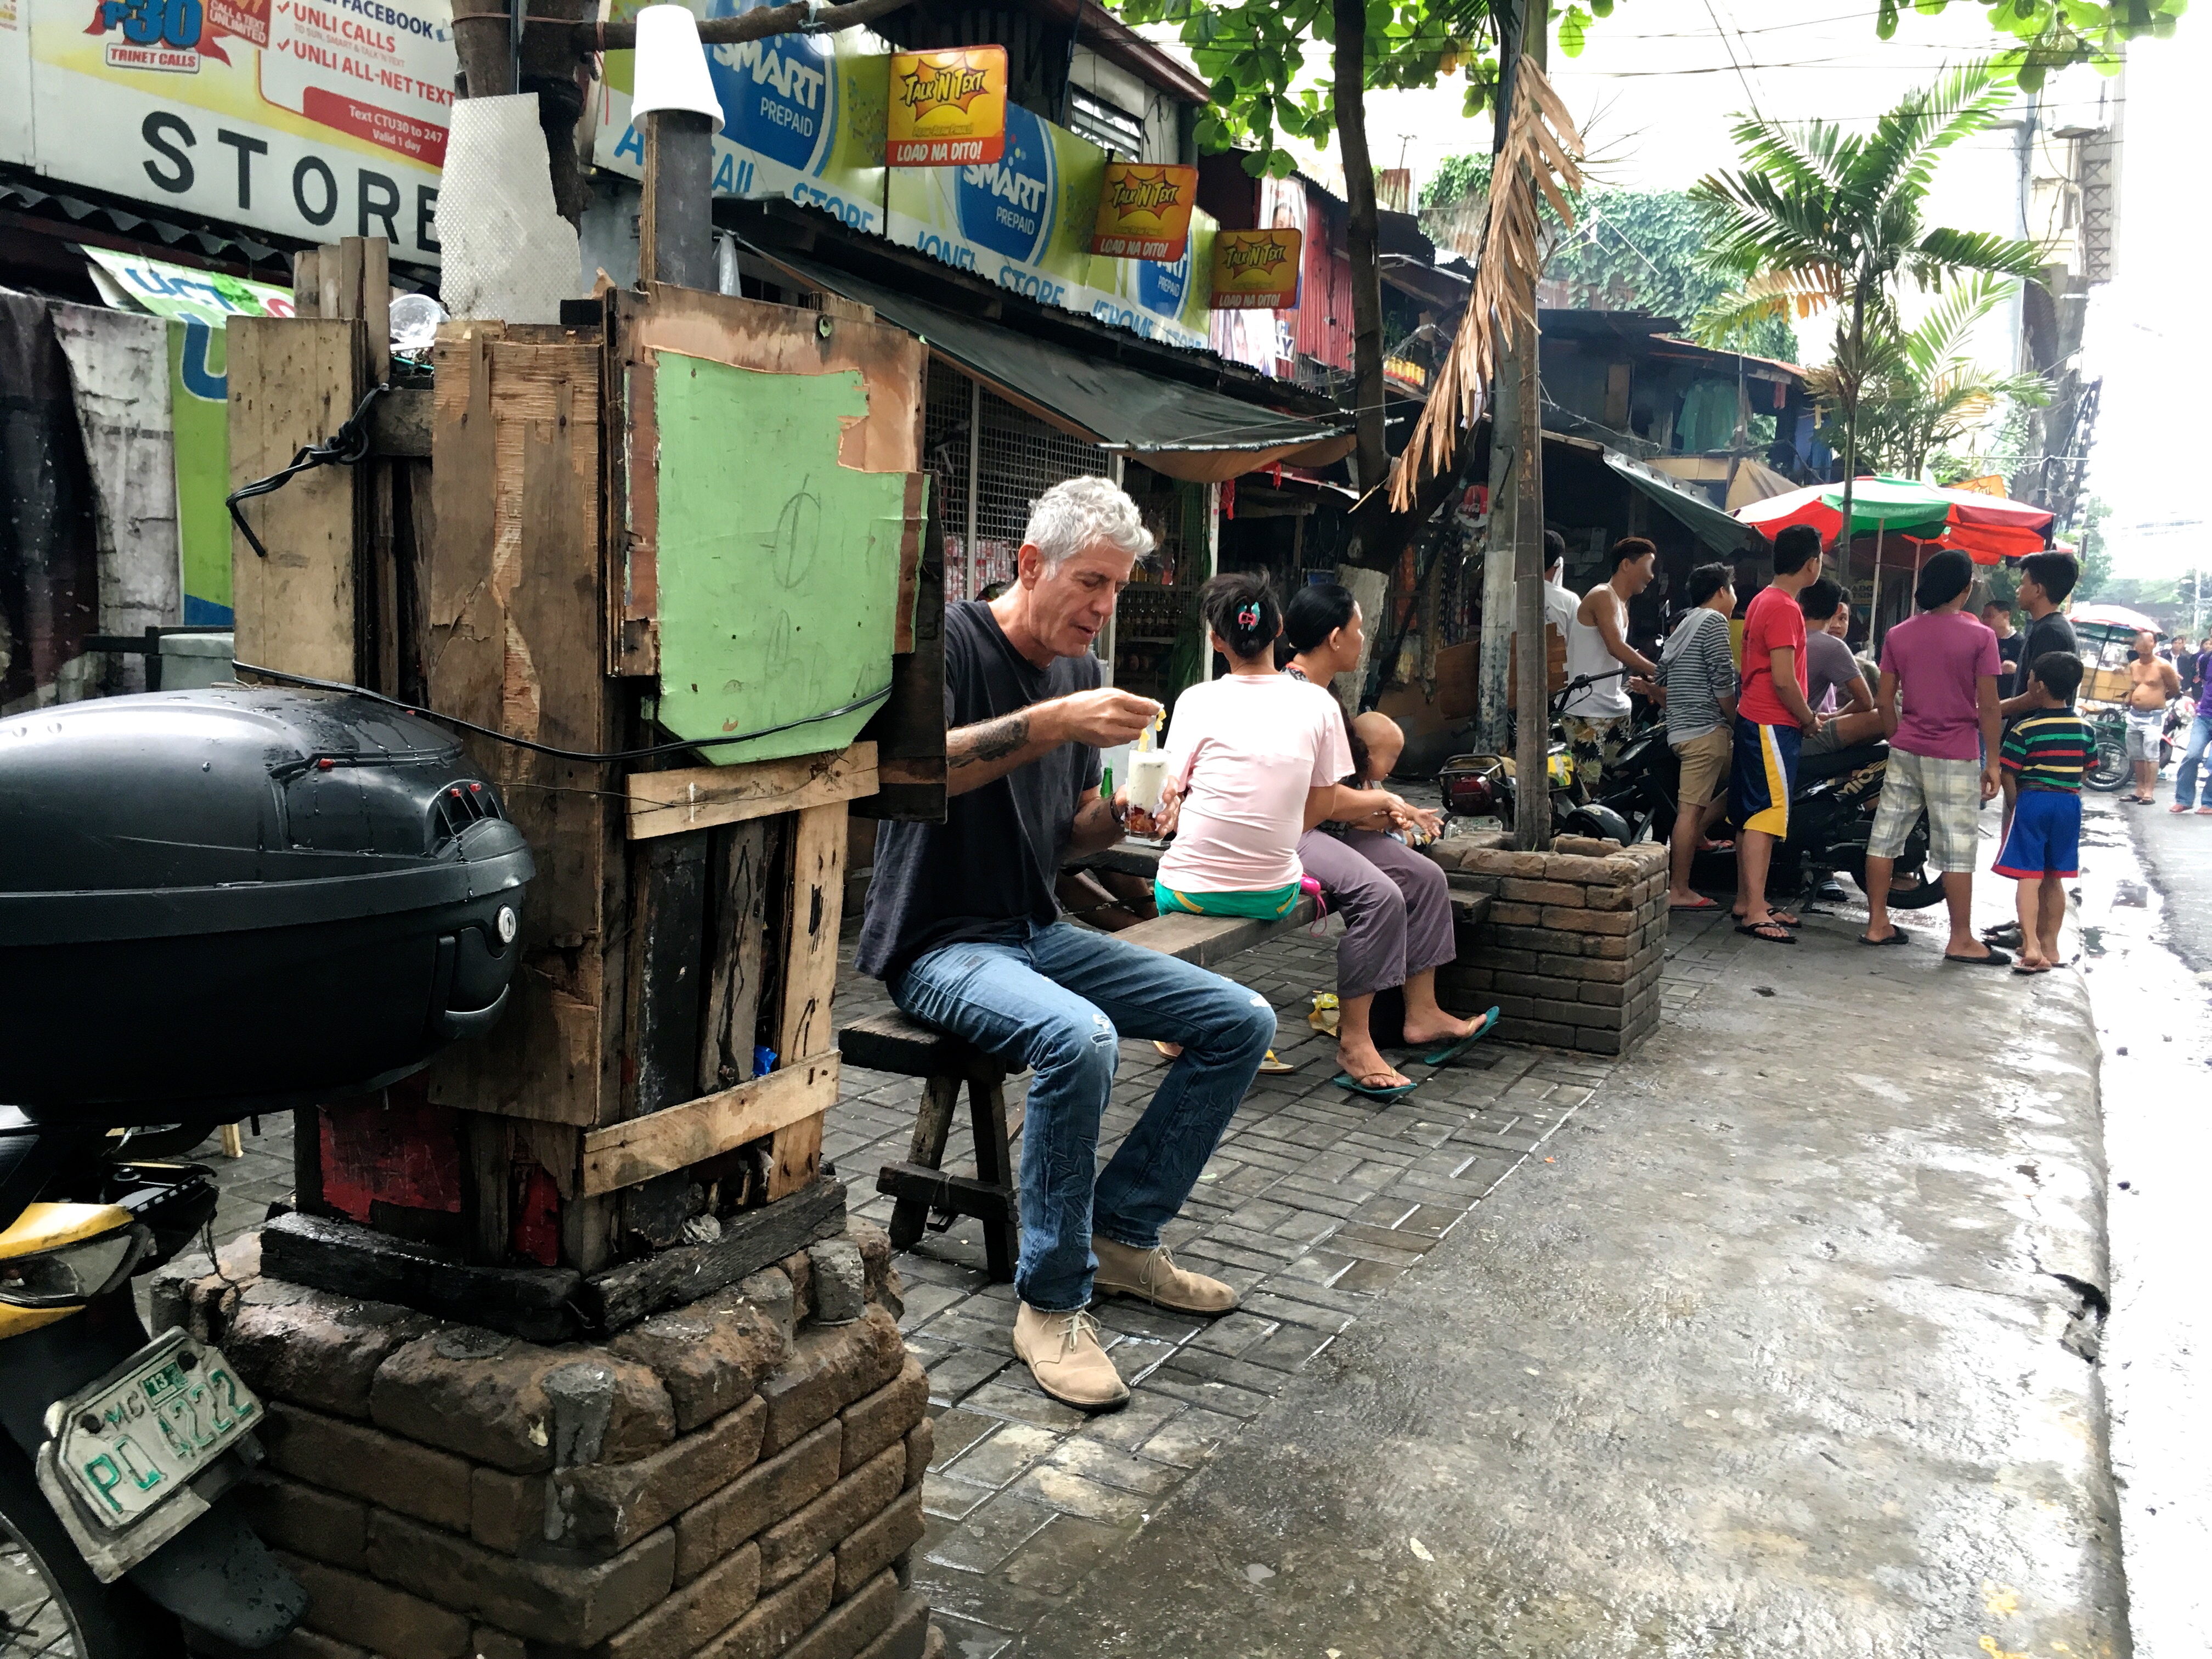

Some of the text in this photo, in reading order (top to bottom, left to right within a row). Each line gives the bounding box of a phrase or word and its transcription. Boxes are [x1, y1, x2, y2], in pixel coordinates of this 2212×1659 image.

[210, 9, 266, 44] UNLIMITED
[294, 2, 337, 33] UNLI
[341, 20, 396, 53] CALLS
[111, 48, 196, 68] TRINET CALLS
[294, 40, 337, 70] UNLI
[341, 56, 413, 94] ALL-NET
[713, 40, 824, 110] SMART
[348, 104, 443, 143] Text CTU30 to 247
[760, 97, 813, 138] PREPAID
[373, 128, 421, 154] Valid 1 day
[896, 140, 983, 162] LOAD NA DITO!
[142, 110, 440, 253] STORE
[963, 163, 1046, 213] SMART
[996, 206, 1035, 236] PREPAID
[1100, 238, 1169, 258] LOAD NA DITO!
[1158, 275, 1180, 297] PREPAID
[1219, 293, 1281, 307] LOAD NA DITO!
[104, 1390, 145, 1431] MC
